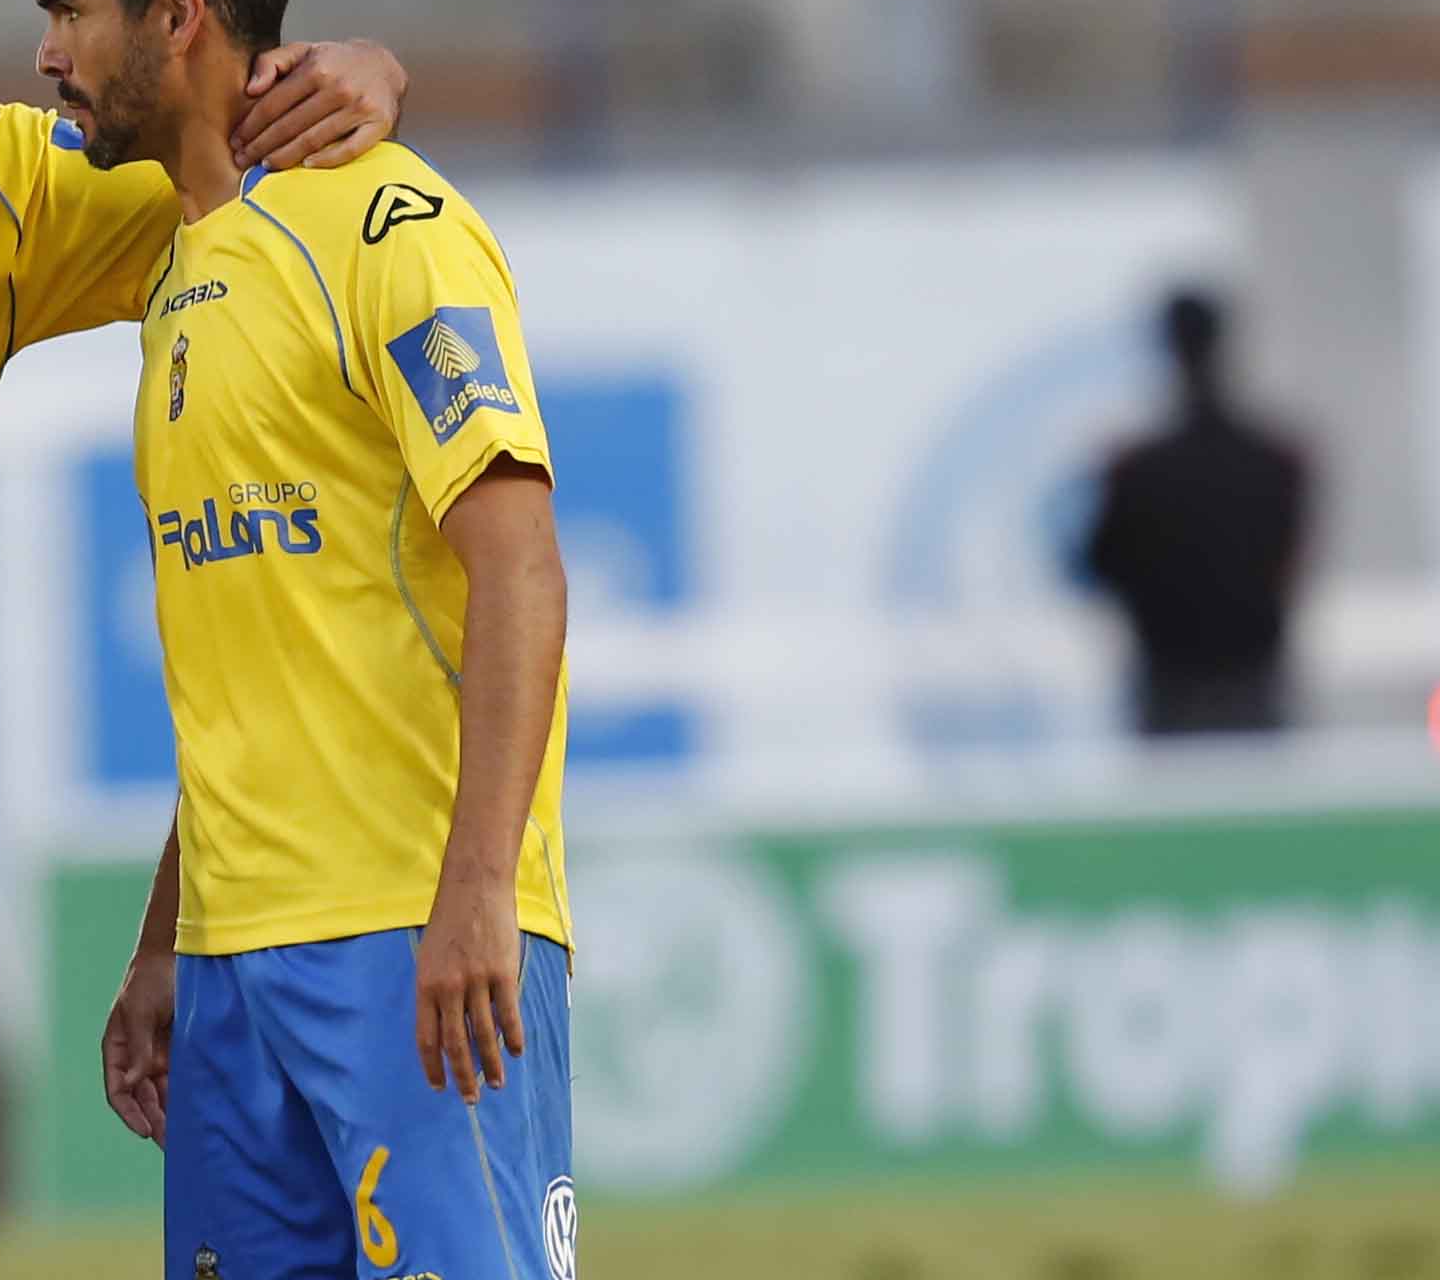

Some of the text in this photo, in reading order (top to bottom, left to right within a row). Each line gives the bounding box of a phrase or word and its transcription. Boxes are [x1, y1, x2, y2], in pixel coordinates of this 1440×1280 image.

[160, 280, 229, 319] ACERBIS
[227, 481, 318, 505] GRUPO
[356, 1145, 399, 1268] 6
